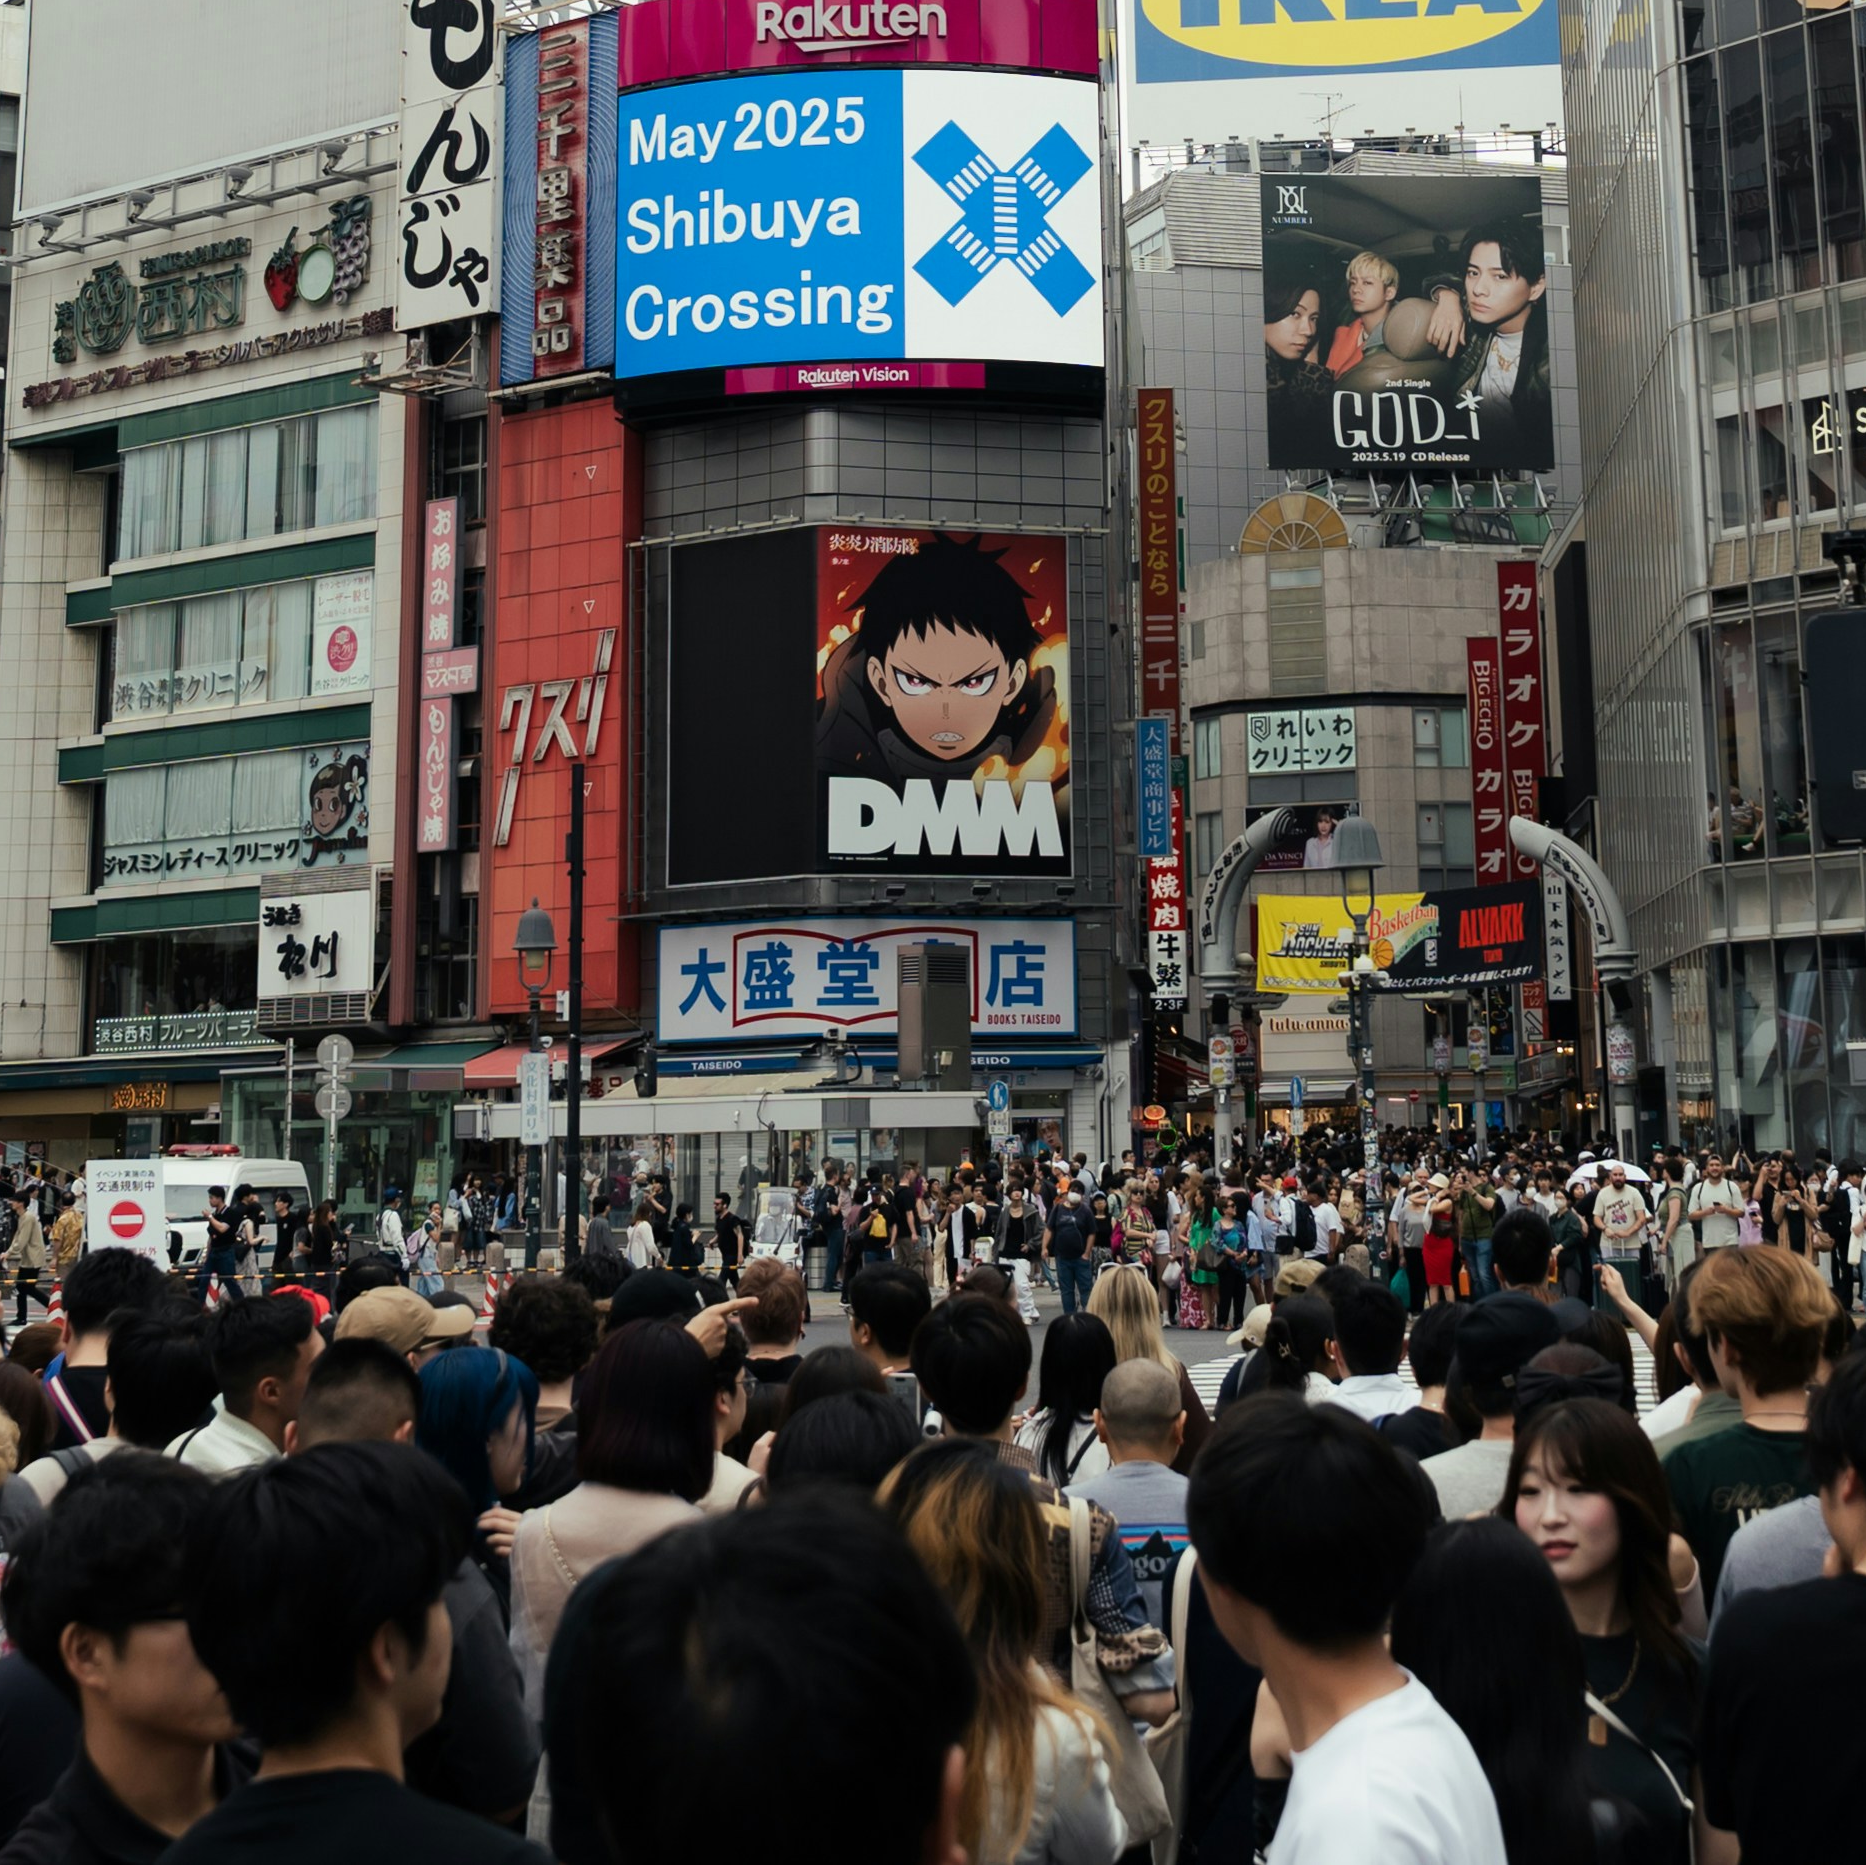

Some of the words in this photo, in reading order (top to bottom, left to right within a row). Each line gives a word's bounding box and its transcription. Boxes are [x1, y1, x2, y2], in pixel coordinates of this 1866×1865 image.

[629, 113, 727, 166] May
[733, 96, 866, 152] 2025
[532, 33, 577, 359] 三千里薬品
[625, 189, 862, 255] Shibuya
[1272, 216, 1303, 225] NUMBER
[136, 263, 246, 345] 西村
[625, 270, 895, 342] Crossing
[216, 318, 363, 365] シルバーアクセサリー
[798, 367, 860, 387] Rakuten
[862, 366, 910, 384] Vision
[1385, 377, 1400, 389] 2nd
[1401, 377, 1432, 390] Single
[1351, 450, 1406, 463] 2025.5.19
[1411, 450, 1427, 462] CD
[1427, 450, 1471, 463] Release
[1143, 397, 1171, 597] クスリのことなら
[828, 533, 920, 555] 炎炎ノ消防隊
[317, 587, 371, 608] レーザー脱毛
[429, 508, 452, 641] お好み焼
[115, 680, 156, 714] 渋谷
[185, 664, 268, 704] クリニック
[1473, 660, 1491, 696] BIG
[1502, 584, 1540, 748] カラオケ
[1276, 714, 1354, 737] れいわ
[1475, 697, 1493, 751] ECHO
[423, 704, 446, 844] もんじゃ焼
[1251, 742, 1354, 768] クリニック
[1143, 726, 1165, 850] 大盛堂商事ビル
[1512, 769, 1533, 810] BIG
[827, 775, 1065, 857] DMM
[1476, 768, 1507, 874] カラオ
[104, 837, 299, 879] ジャスミンレディースクリニック
[1278, 851, 1303, 861] VINCI
[1201, 840, 1243, 939] 渋谷センター街
[1549, 846, 1609, 938] 渋谷センター街
[1368, 903, 1439, 942] Basketball
[1458, 902, 1525, 949] ALVARK
[1547, 883, 1566, 998] 山下本気うどん
[678, 938, 1046, 1017] 大盛堂店
[1156, 933, 1182, 988] 牛繁
[1318, 960, 1347, 969] SHIBUYA
[100, 1025, 153, 1046] 渋谷西村
[987, 1013, 1018, 1026] BOOKS
[1020, 1012, 1062, 1026] TAISEIDO
[691, 1060, 742, 1071] TAISEIDO
[95, 1181, 156, 1194] 交通規制中
[96, 1169, 156, 1179] イベント実施の為
